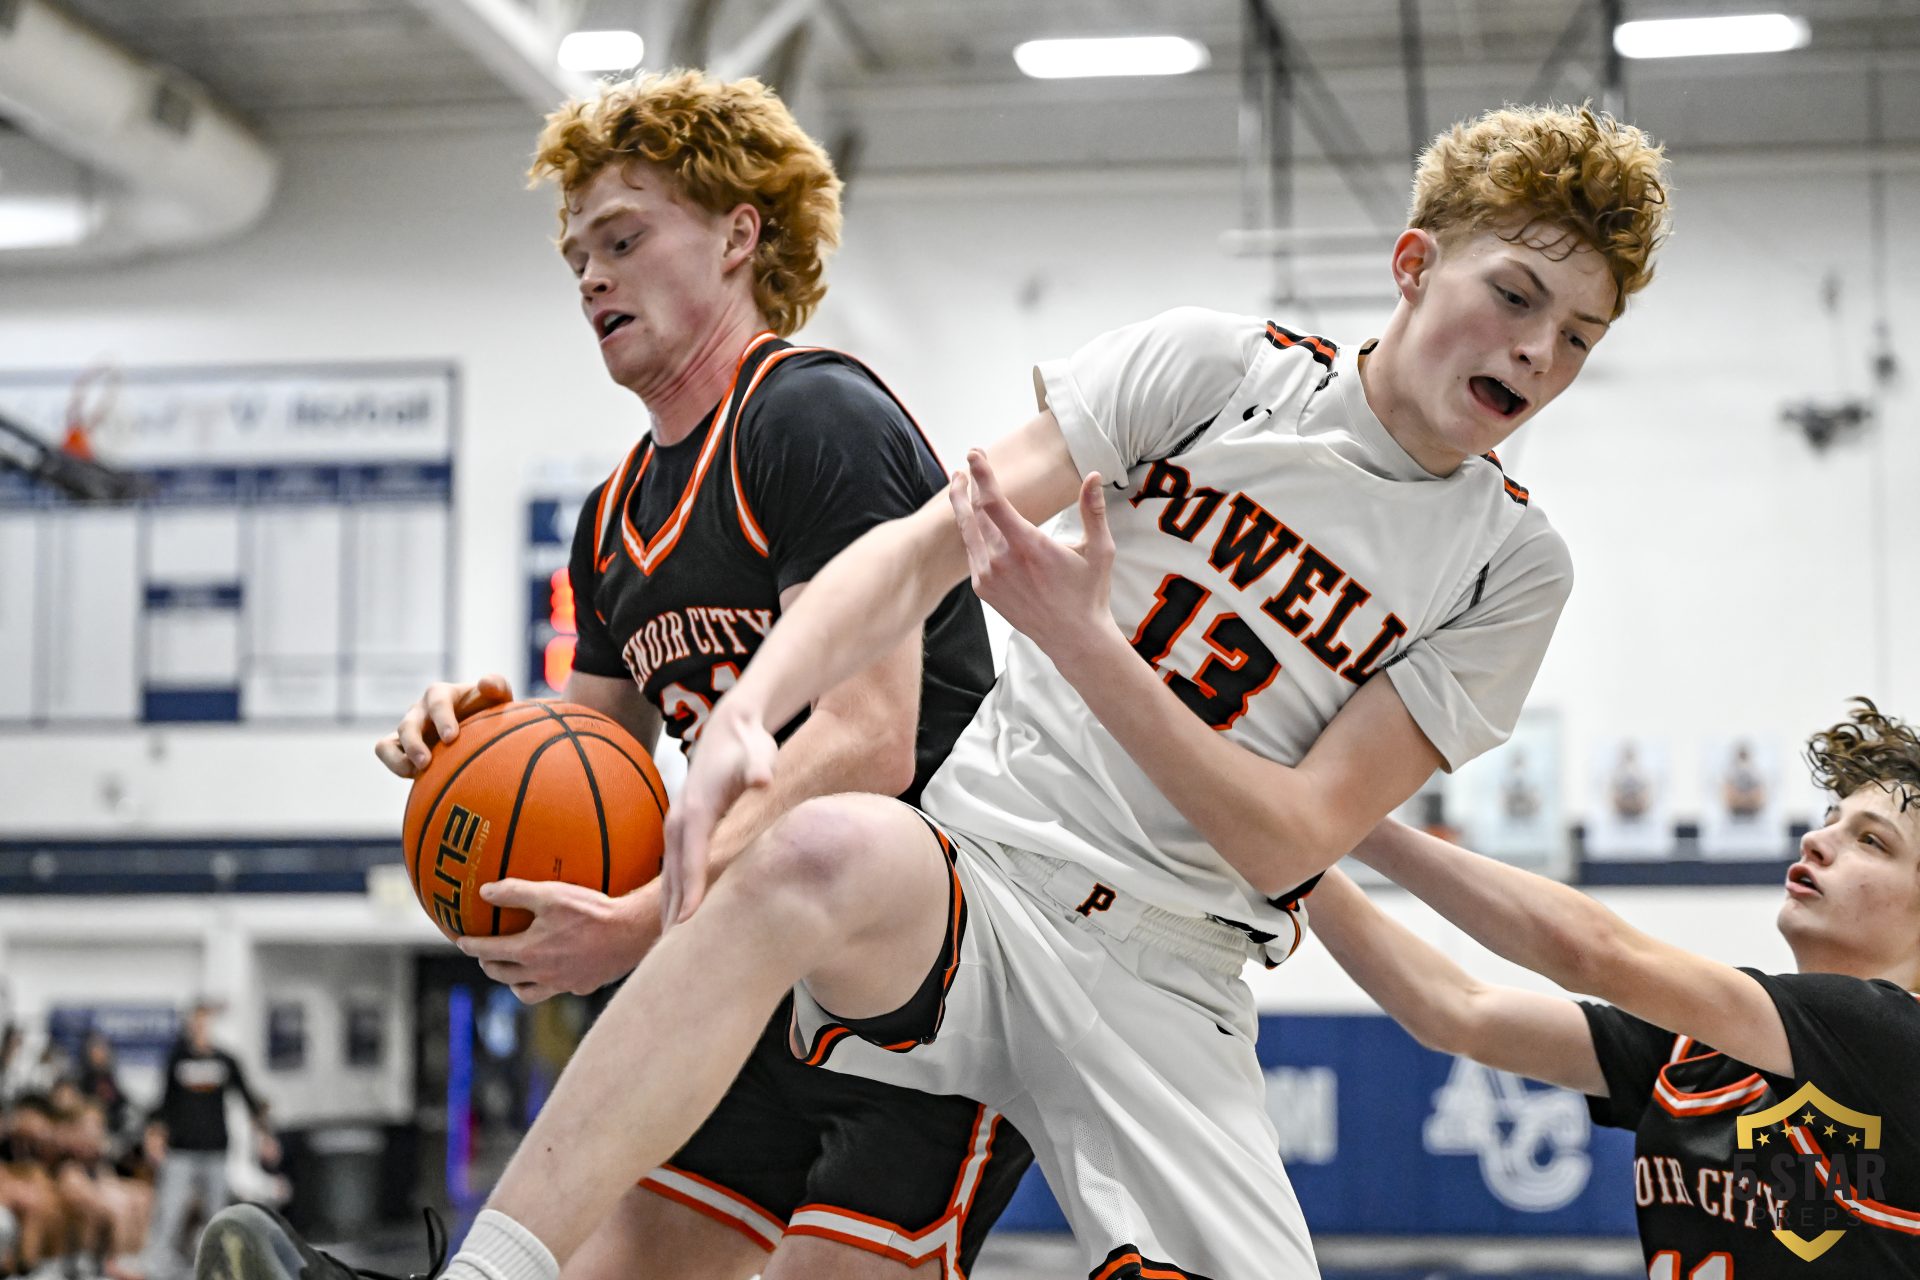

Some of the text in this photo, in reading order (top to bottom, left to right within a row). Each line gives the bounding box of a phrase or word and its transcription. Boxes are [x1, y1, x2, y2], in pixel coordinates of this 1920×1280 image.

[1128, 458, 1408, 687] POWELL
[621, 611, 692, 694] ENOIR
[685, 606, 774, 655] CITY
[1129, 573, 1282, 731] 13
[433, 803, 482, 937] ELITE
[1075, 881, 1117, 918] P
[1634, 1156, 1695, 1208] OIR
